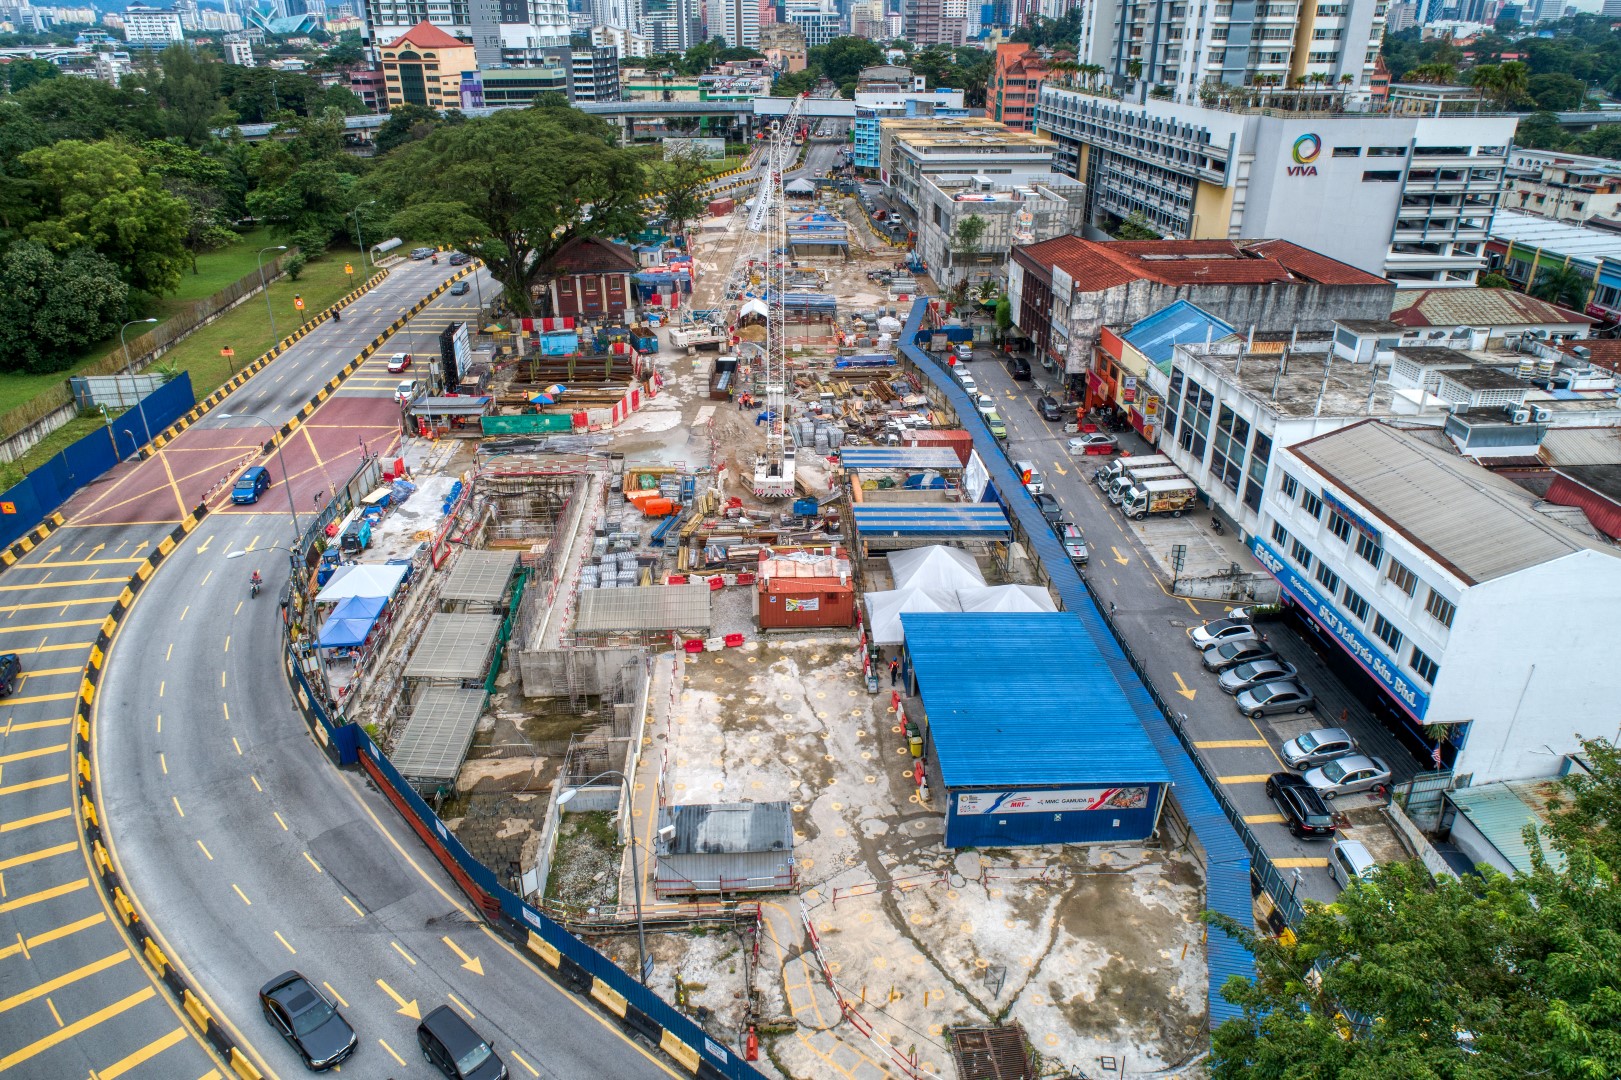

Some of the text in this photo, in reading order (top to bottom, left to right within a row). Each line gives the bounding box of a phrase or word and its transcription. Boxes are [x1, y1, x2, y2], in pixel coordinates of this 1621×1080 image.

[1287, 166, 1318, 177] VIVA
[755, 206, 765, 221] MMC
[1254, 543, 1284, 574] SKF
[1319, 605, 1338, 628] SKF
[1336, 621, 1373, 665] Malaysia
[1372, 657, 1393, 685] Sdn.
[1393, 676, 1417, 708] Bhd.
